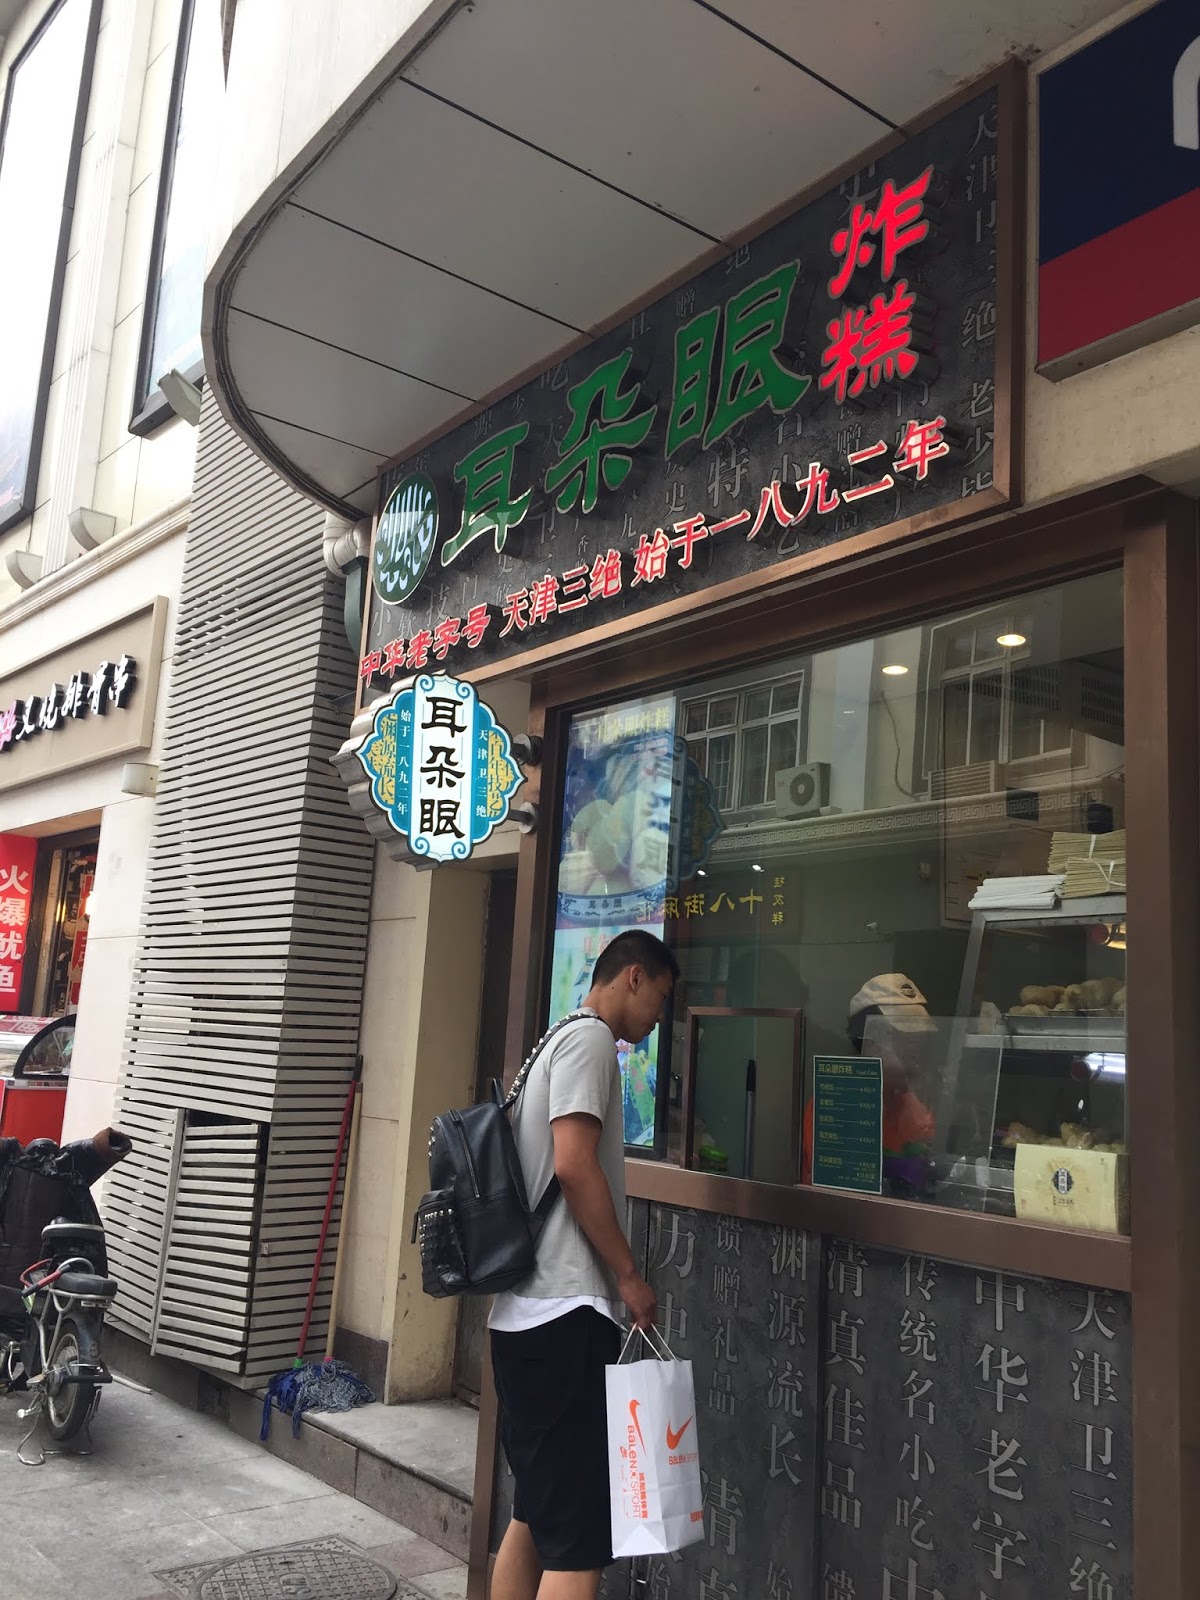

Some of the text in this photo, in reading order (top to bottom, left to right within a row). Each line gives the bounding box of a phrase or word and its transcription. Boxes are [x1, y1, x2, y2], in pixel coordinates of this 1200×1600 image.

[441, 259, 813, 567] 耳朵眼
[819, 163, 934, 402] 炸糕
[359, 602, 491, 689] 中华老字号
[498, 548, 623, 638] 天津三绝
[632, 414, 949, 586] 始于一八九二年
[397, 709, 412, 815] 始于一八九二年
[420, 696, 467, 838] 耳朵眼
[476, 730, 488, 818] 天津卫三绝
[763, 1225, 808, 1486] 渊源流长
[820, 1239, 868, 1529] 清真佳品
[895, 1254, 940, 1551] 传统名小吃
[971, 1275, 1030, 1600] 中华老字
